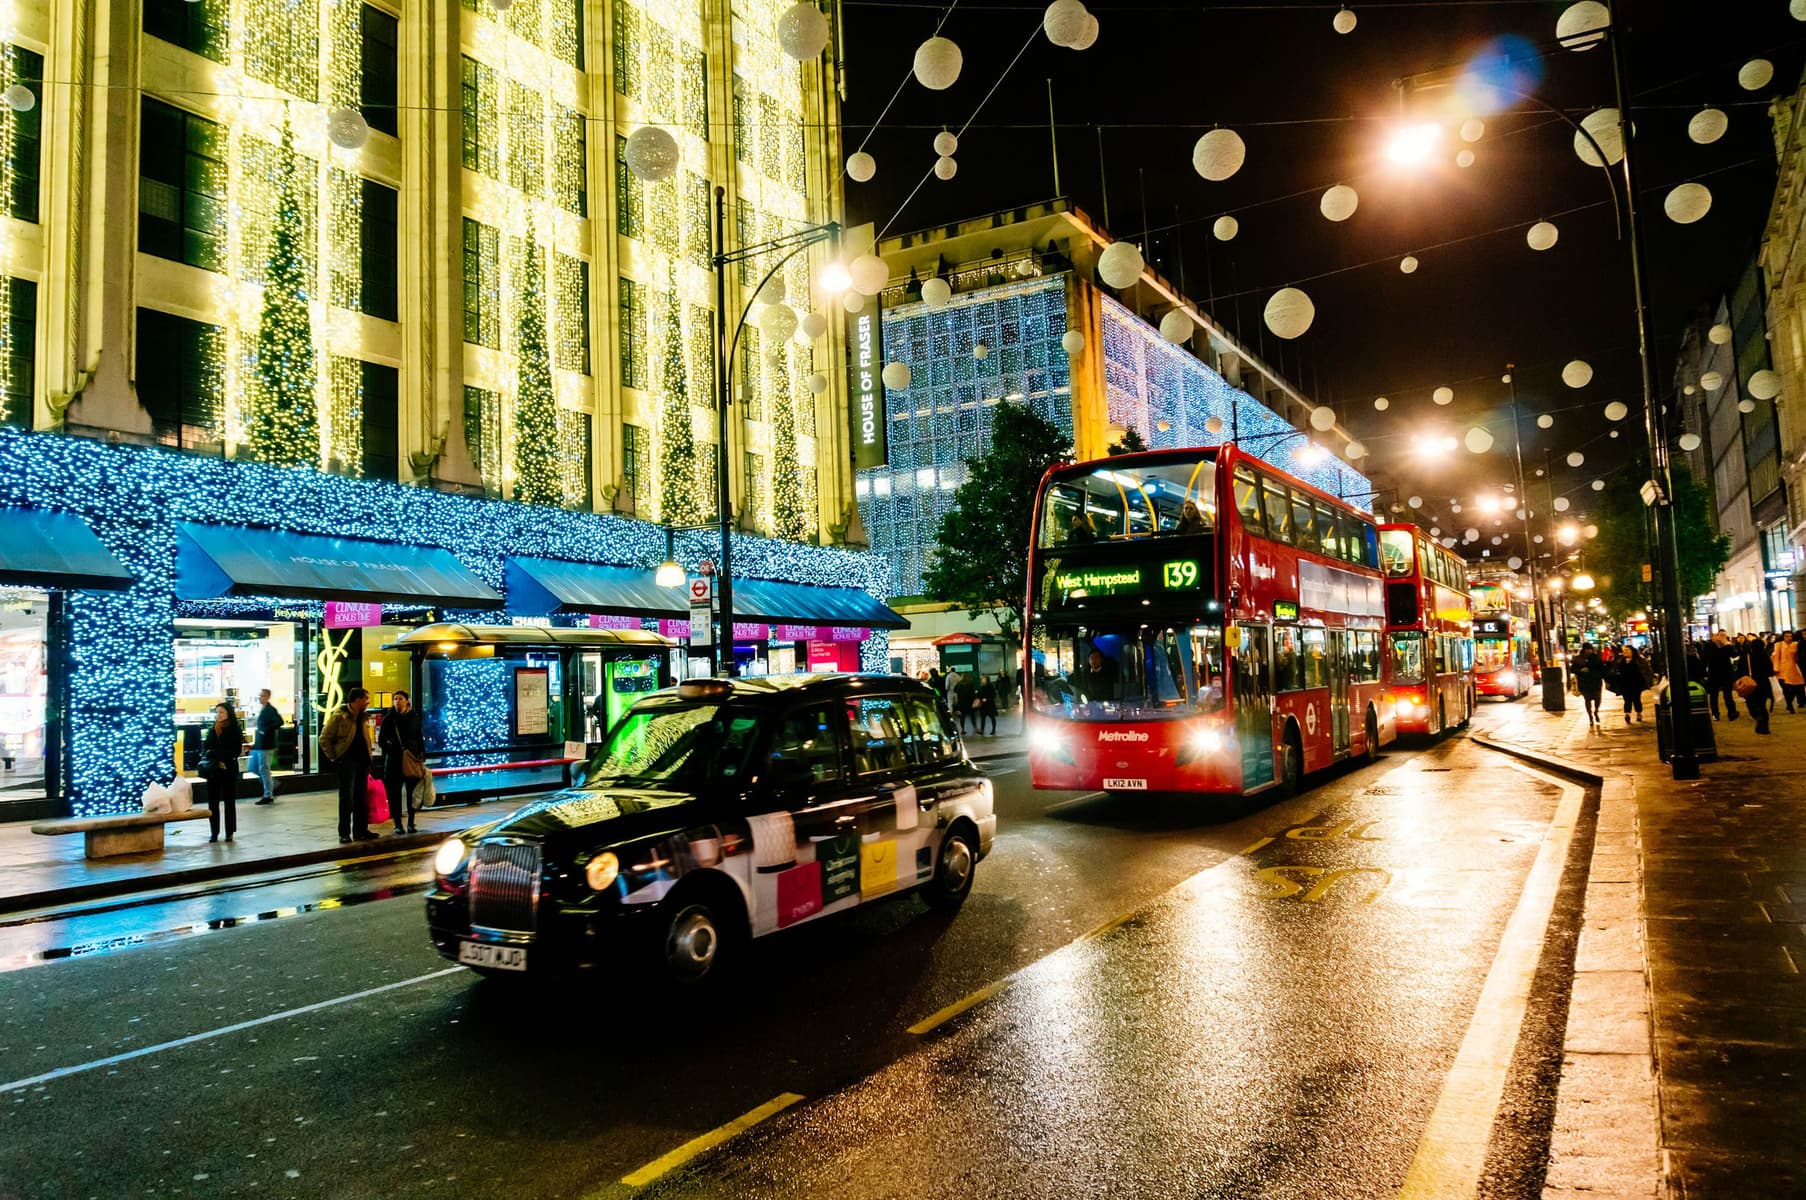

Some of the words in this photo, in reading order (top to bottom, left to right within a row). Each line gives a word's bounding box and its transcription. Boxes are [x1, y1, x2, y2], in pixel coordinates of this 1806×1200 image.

[859, 315, 871, 368] FRASER
[860, 369, 873, 391] OF
[861, 393, 875, 444] HOUSE
[1056, 573, 1083, 589] West
[1084, 570, 1140, 588] Hampstead
[1163, 561, 1197, 588] 139
[335, 614, 357, 623] BONUS
[357, 612, 370, 622] TIME
[511, 615, 553, 628] CHANEL
[1098, 730, 1149, 742] Metroline
[1107, 780, 1125, 788] LK12
[1127, 779, 1143, 788] AVN
